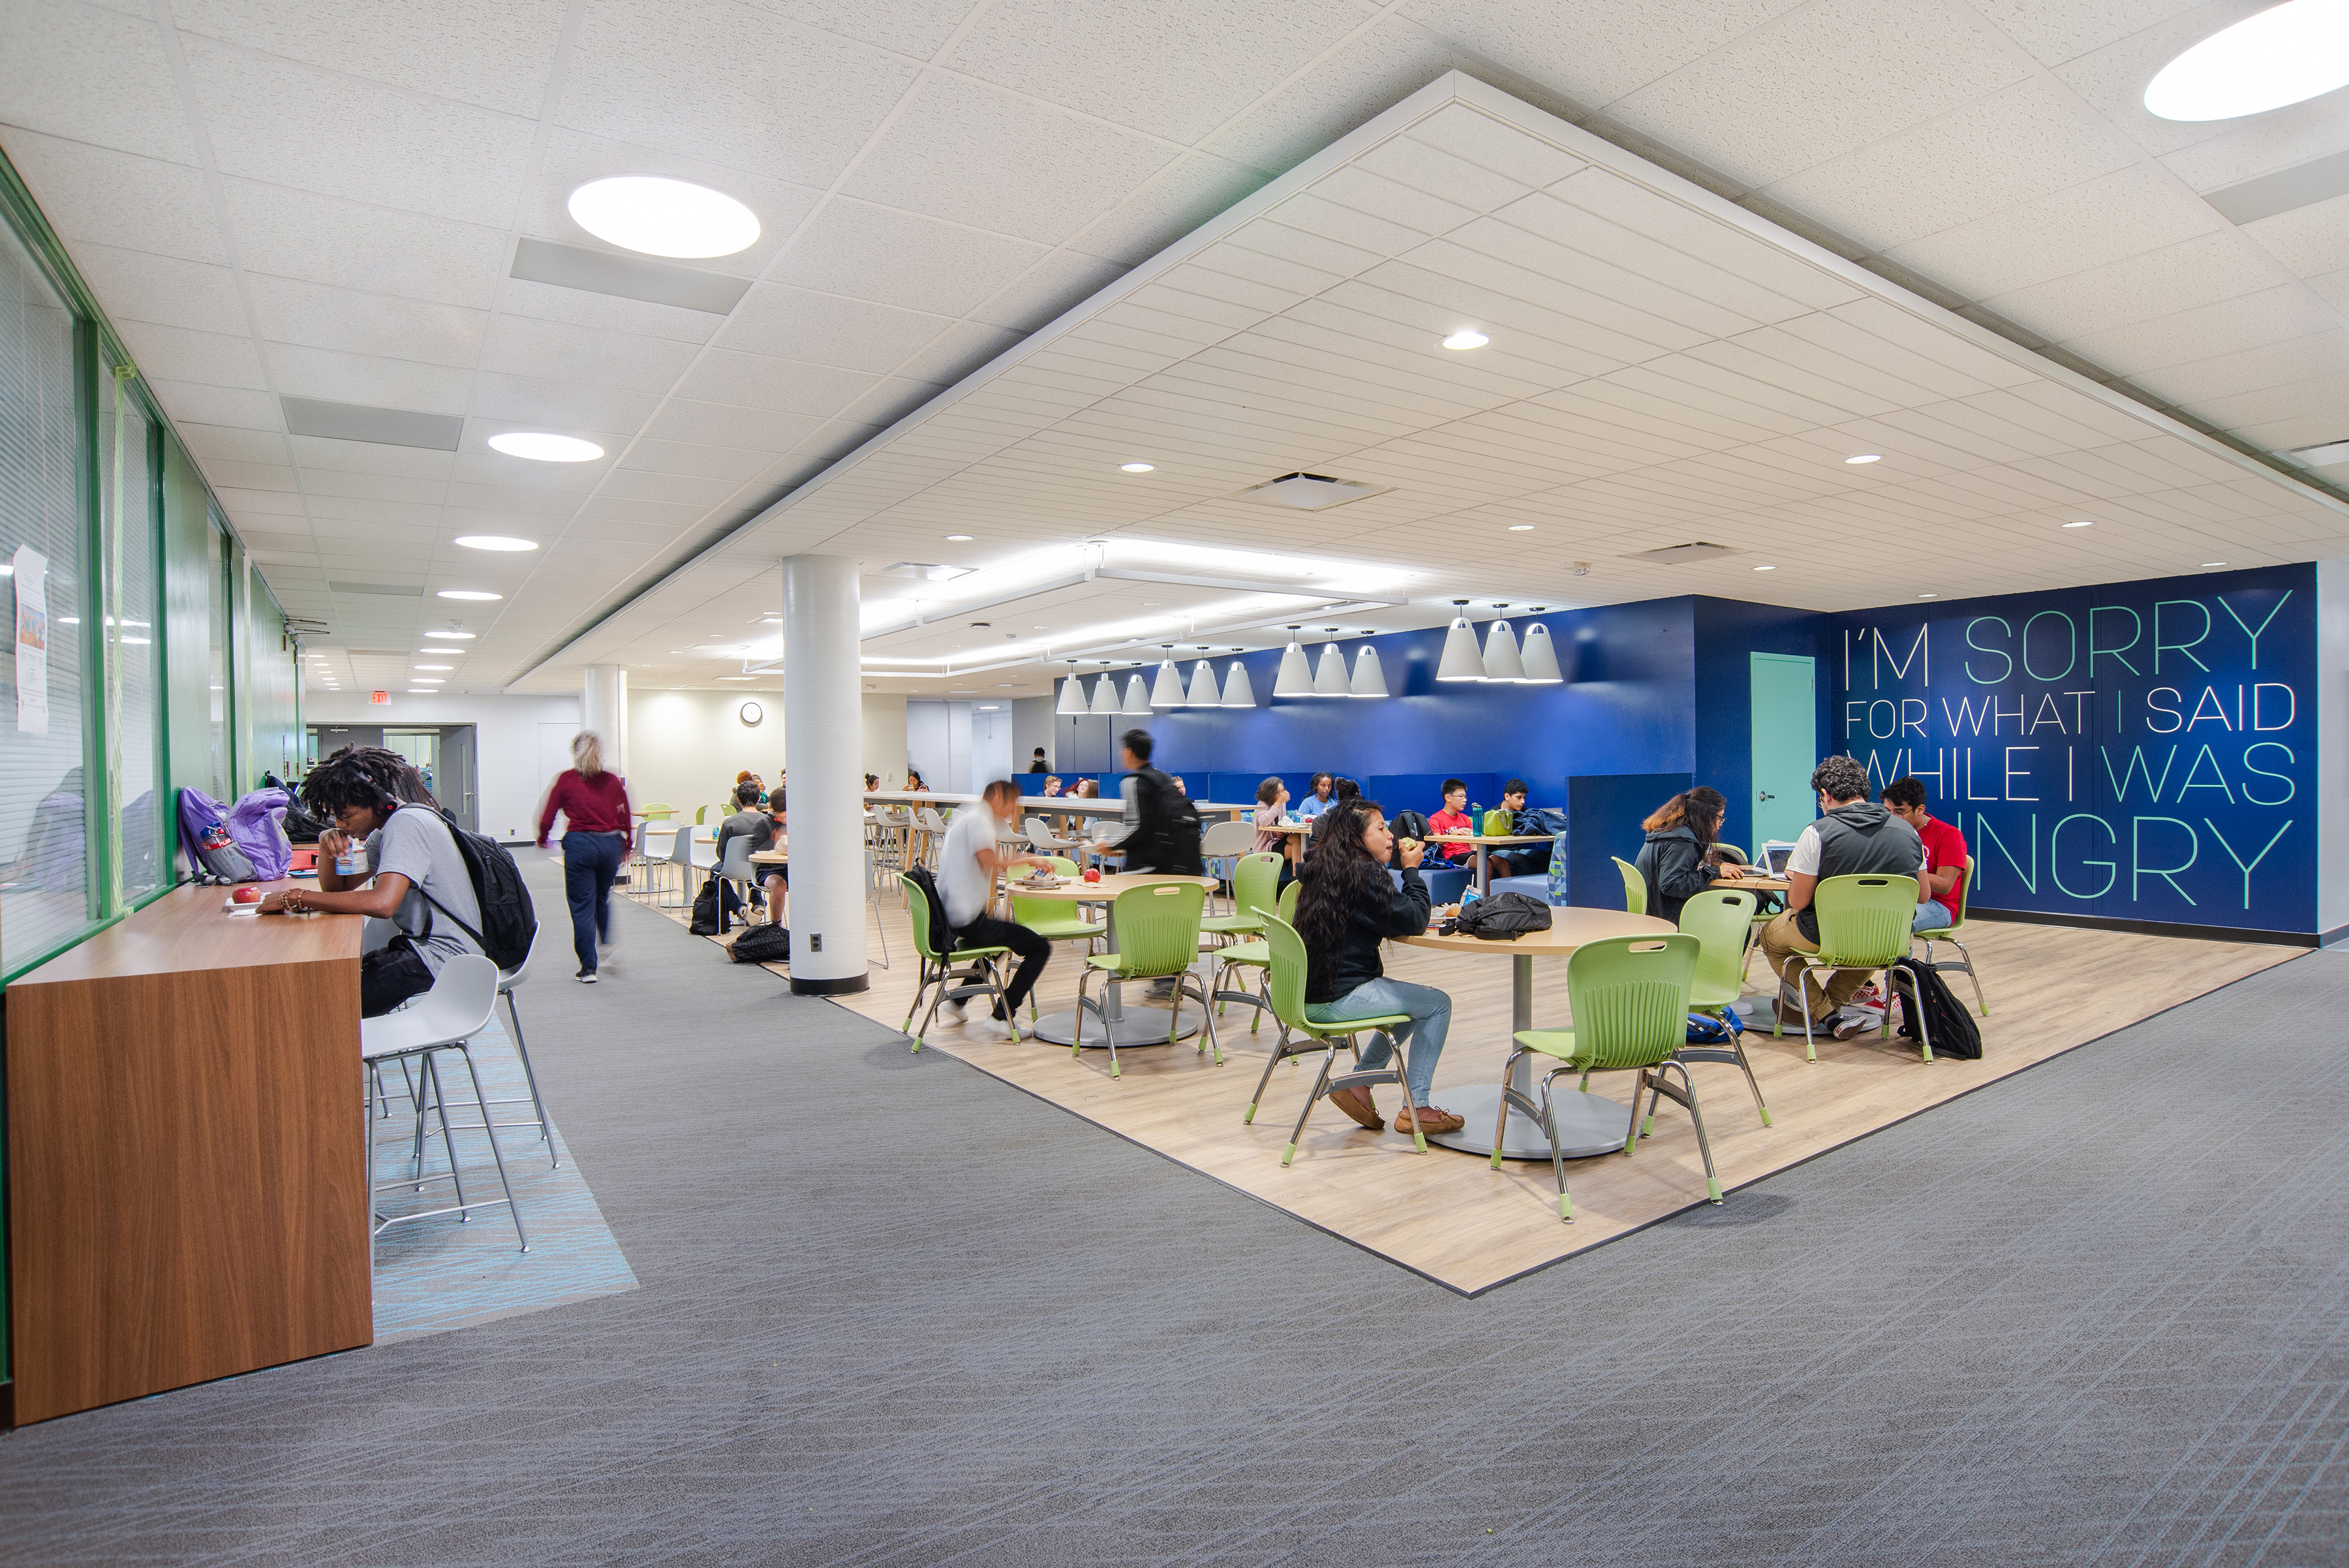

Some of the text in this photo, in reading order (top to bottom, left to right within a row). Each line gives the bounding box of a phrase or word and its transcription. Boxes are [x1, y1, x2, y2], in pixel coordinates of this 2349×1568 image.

[1845, 589, 2293, 691] I'M SORRY
[372, 692, 388, 703] EXIT
[1847, 683, 2295, 739] FOR WHAT I SAID
[2069, 746, 2073, 802] I
[2100, 742, 2295, 805] WAS
[1958, 812, 2294, 910] NGRY
